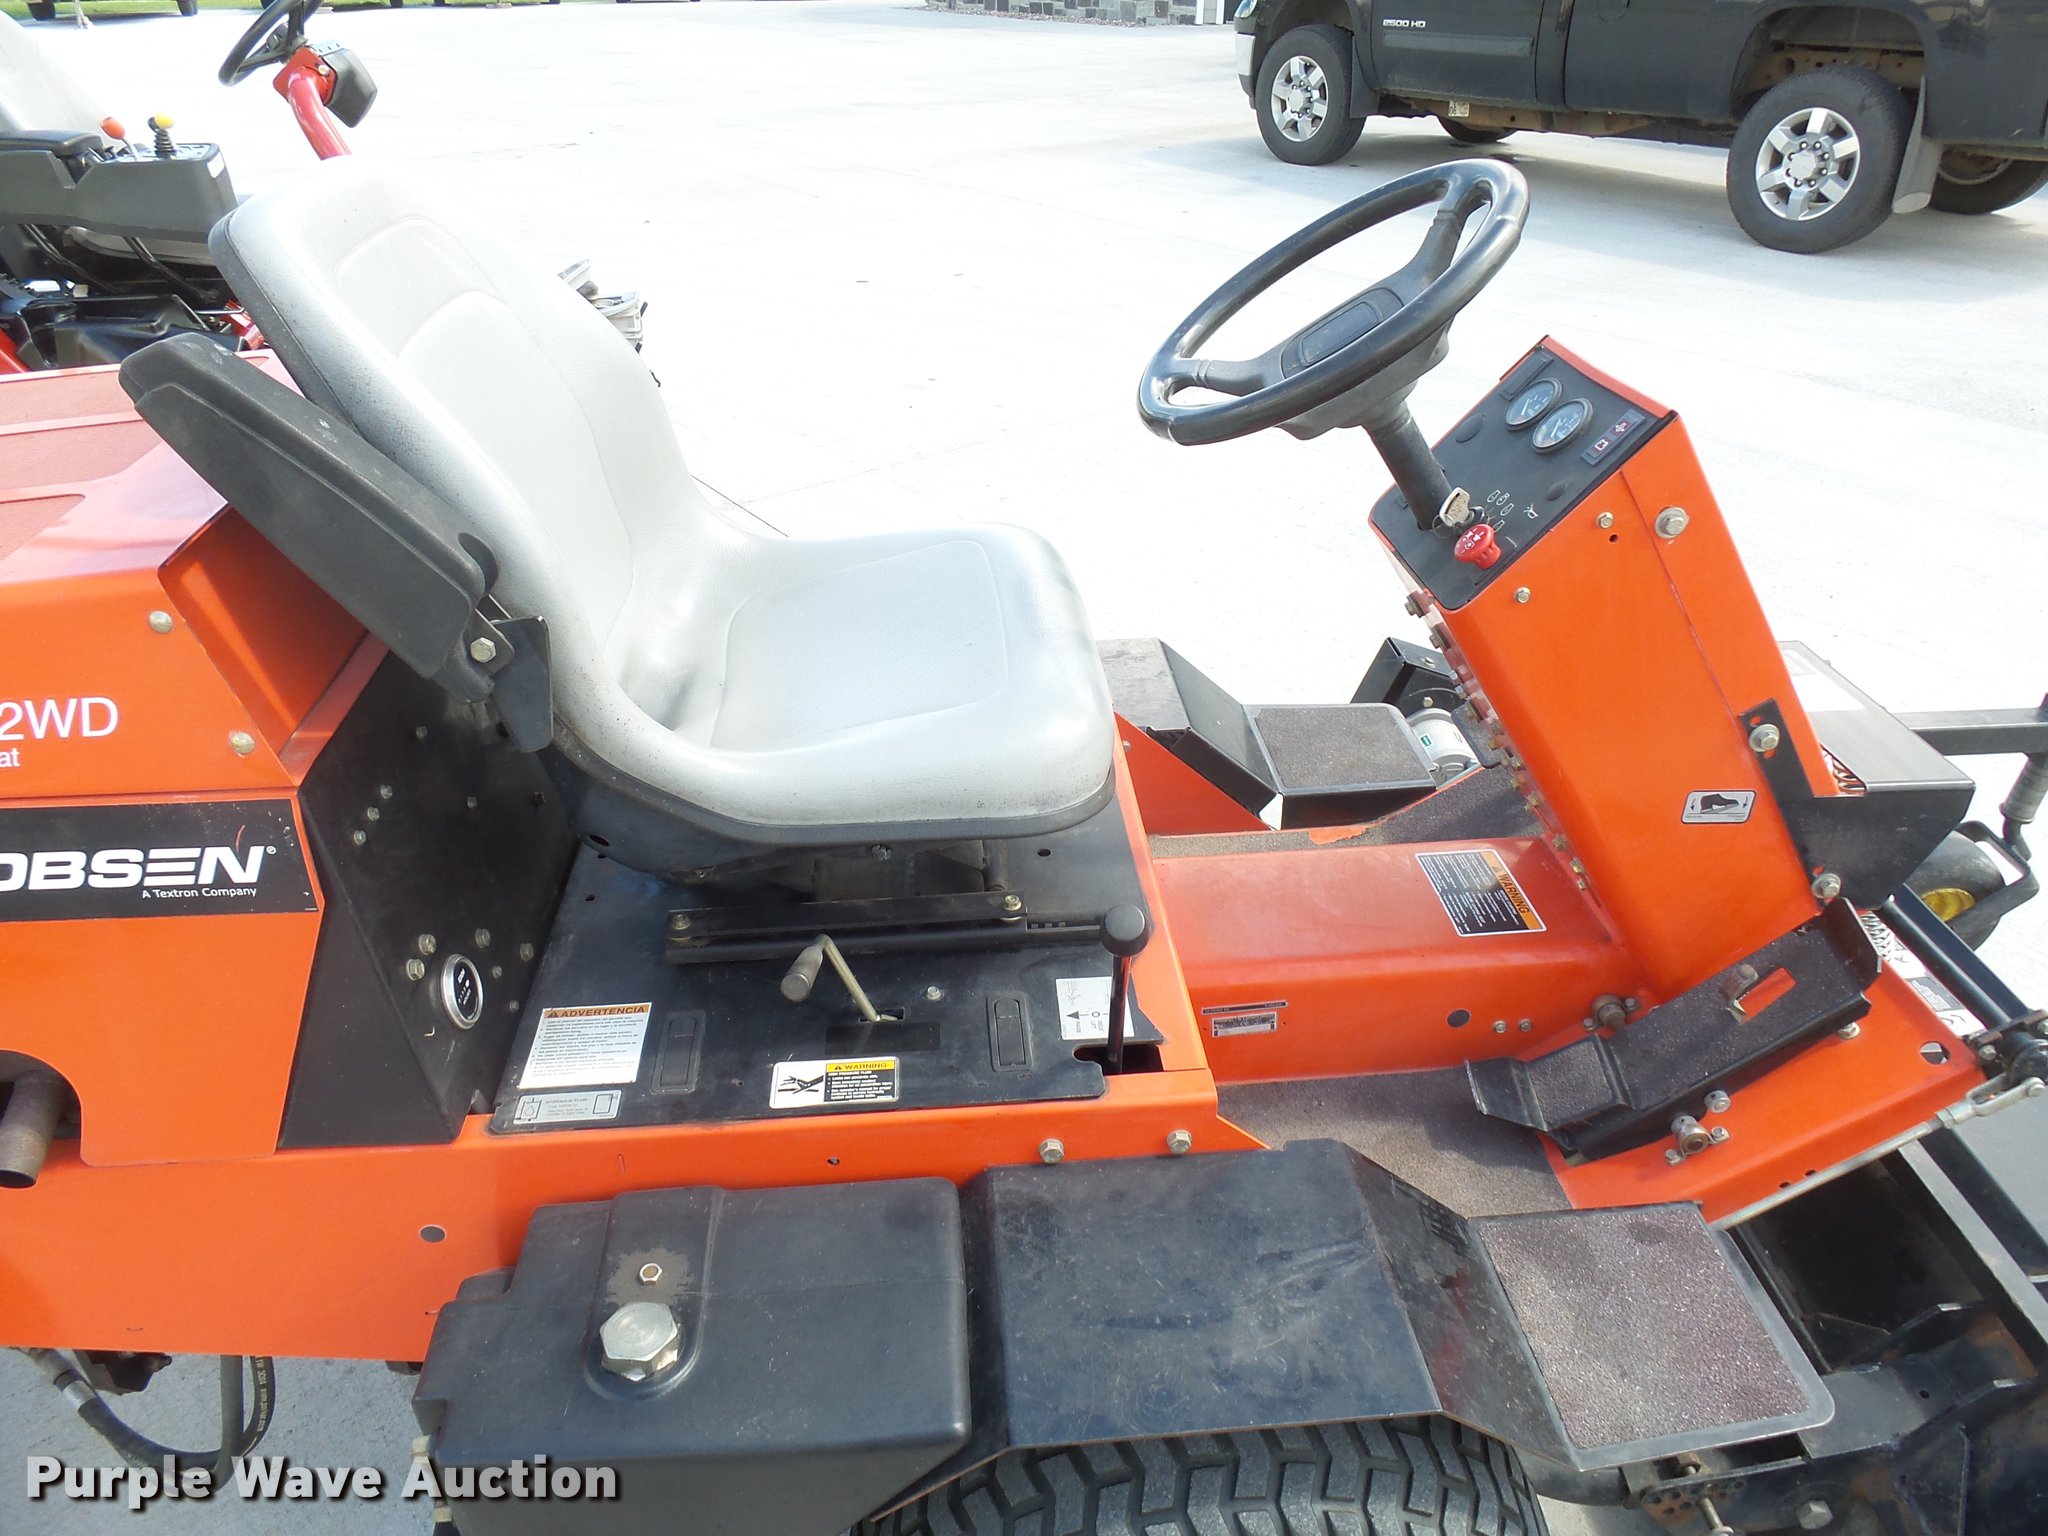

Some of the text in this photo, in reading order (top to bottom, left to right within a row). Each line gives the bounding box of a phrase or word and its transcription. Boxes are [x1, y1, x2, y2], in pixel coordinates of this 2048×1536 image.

[1382, 19, 1426, 28] 2500 HD
[0, 697, 118, 741] 2WD
[142, 887, 257, 898] A Textron Company
[1498, 874, 1529, 914] WARNING
[561, 1006, 645, 1018] ADVERTENCIA
[844, 1062, 887, 1070] WARNING
